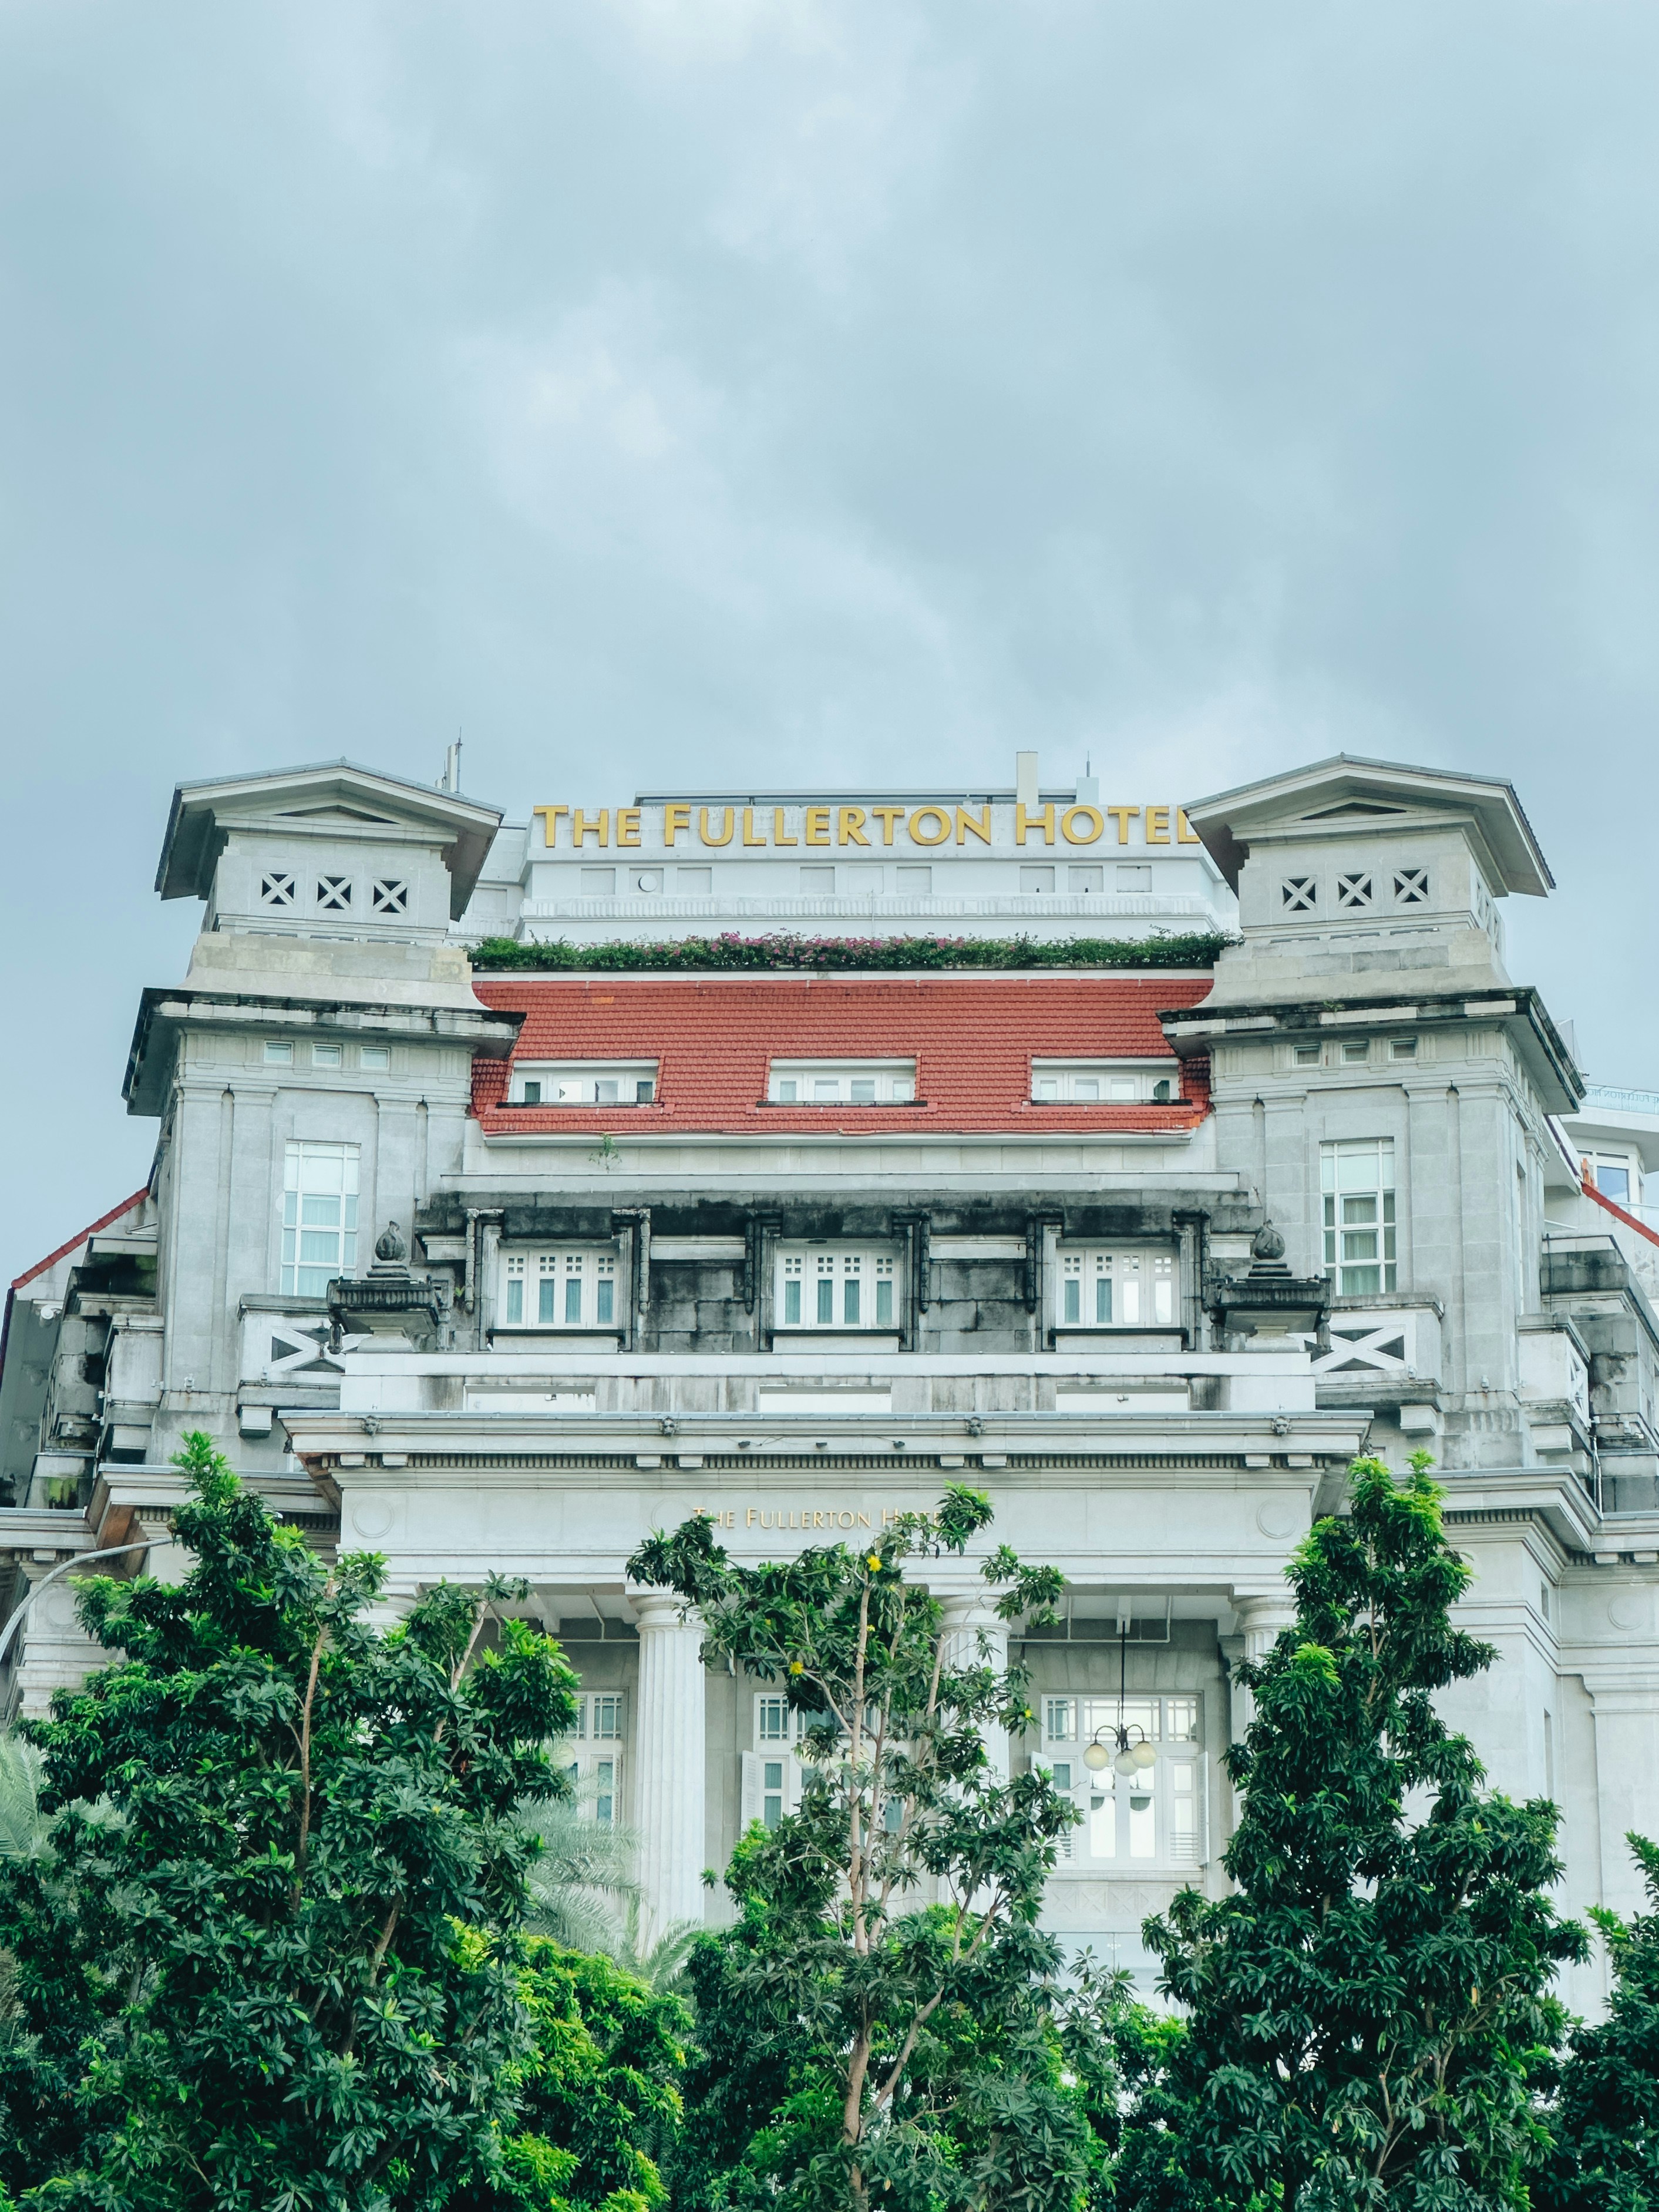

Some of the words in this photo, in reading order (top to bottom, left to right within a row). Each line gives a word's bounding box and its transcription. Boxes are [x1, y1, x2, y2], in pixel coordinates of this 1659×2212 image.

[533, 805, 641, 848] THE
[664, 804, 991, 846] FULLERTON
[1016, 802, 1201, 845] HOTEL
[746, 1508, 871, 1529] FULLERTON
